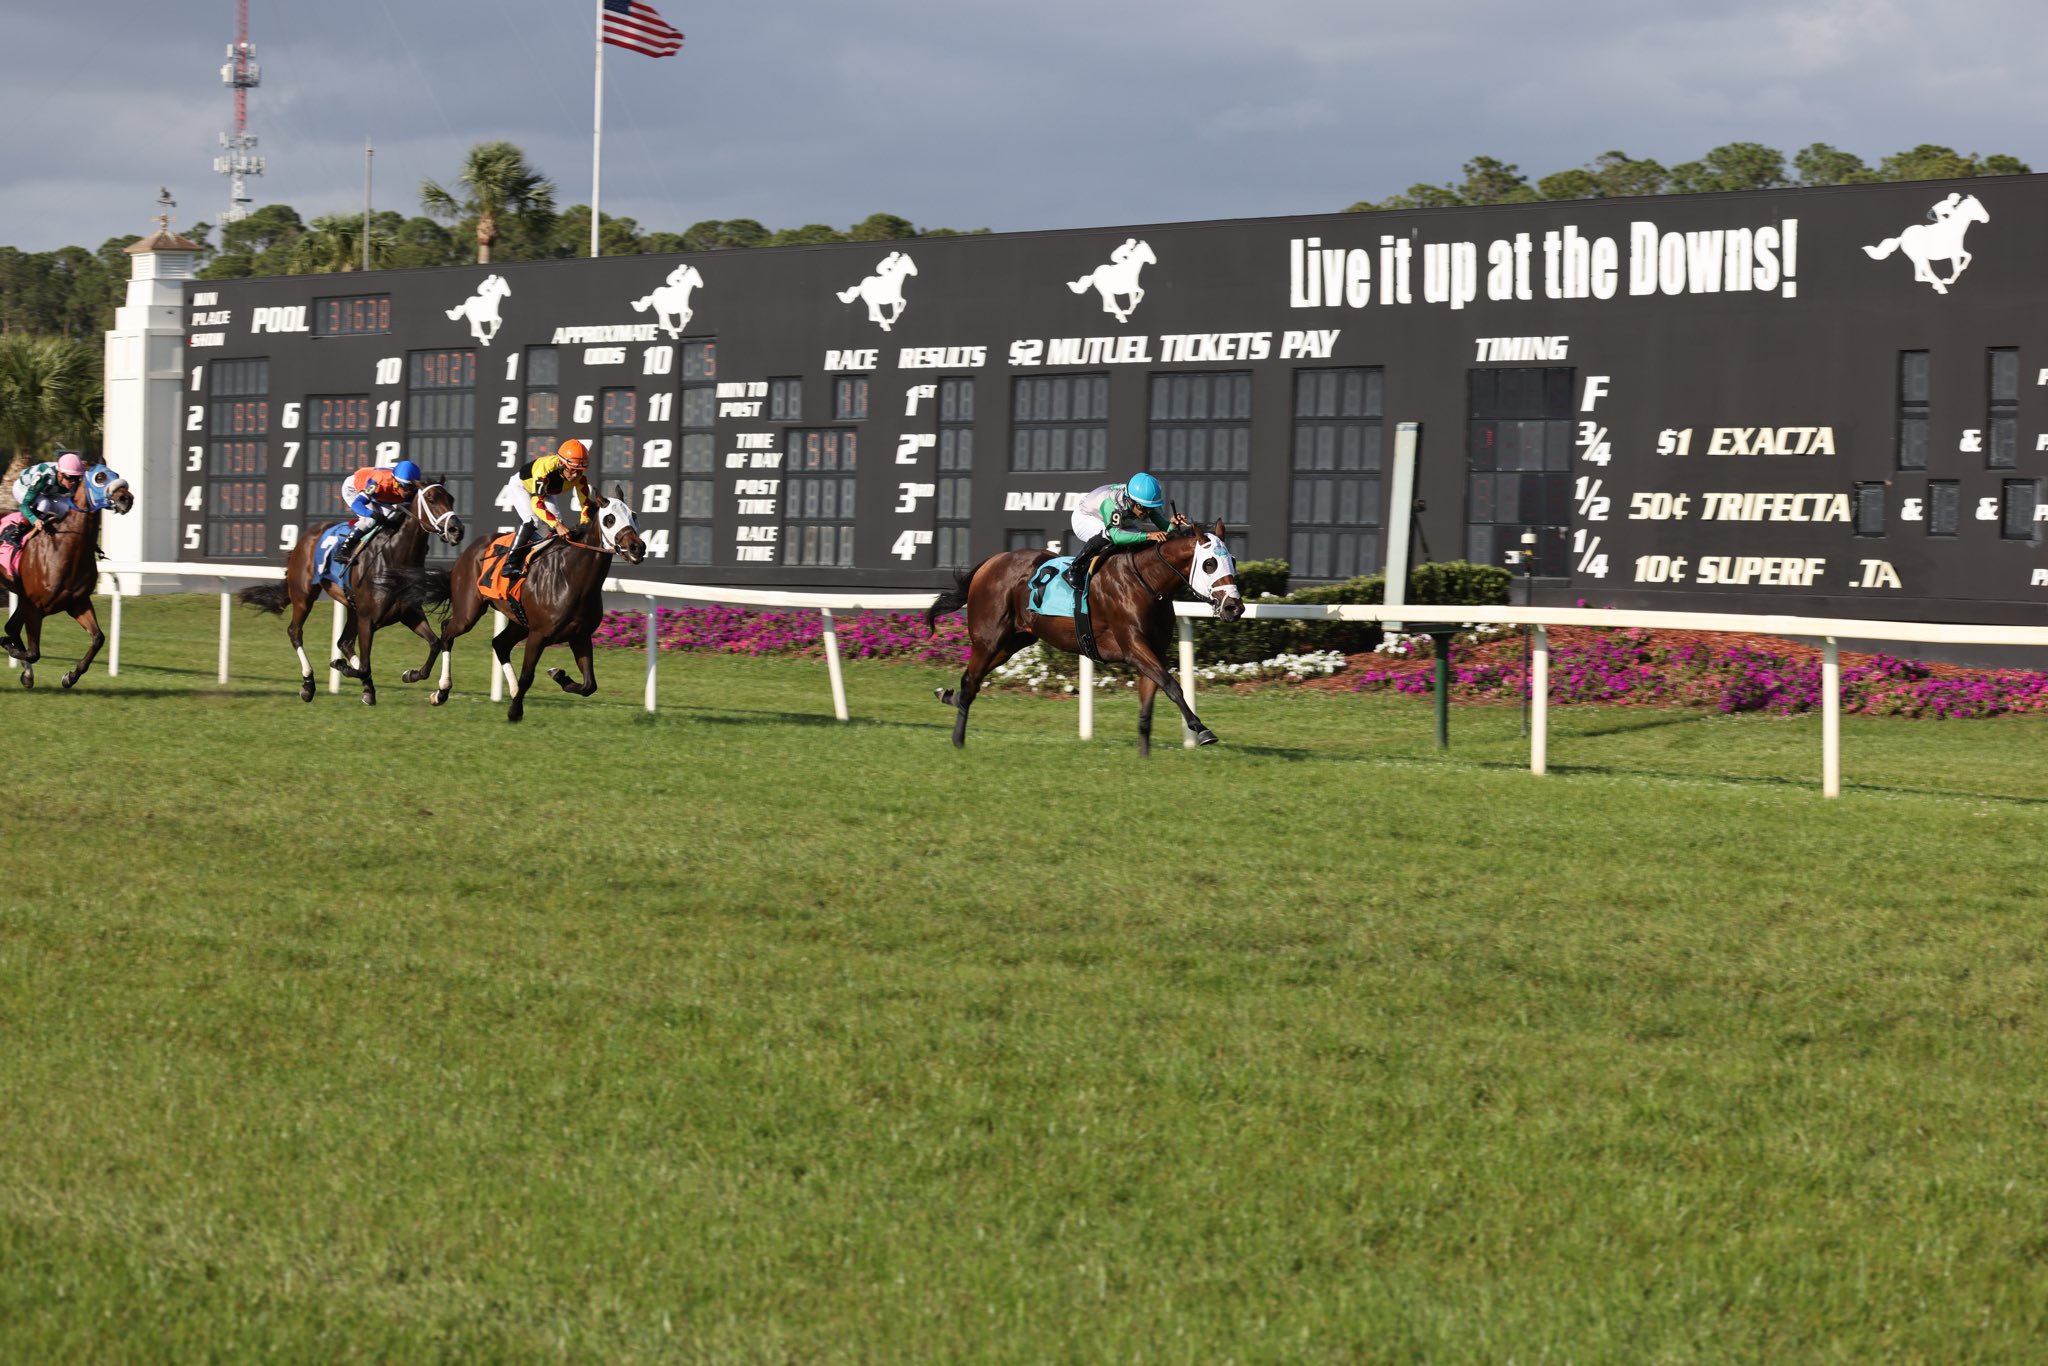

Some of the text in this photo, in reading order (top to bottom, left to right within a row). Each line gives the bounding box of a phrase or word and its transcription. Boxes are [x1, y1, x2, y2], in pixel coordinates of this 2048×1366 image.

[1291, 218, 1799, 310] Live it up at the Downs!
[191, 310, 231, 326] PLACE
[250, 306, 310, 333] POOL
[551, 324, 659, 344] APPROXIMATE
[824, 346, 987, 371] RACE RESULTS
[1008, 329, 1341, 366] $2 MUTUEL TICKETS PAY
[1475, 336, 1570, 361] TIMING
[375, 357, 403, 385] 10
[506, 353, 520, 380] 1
[643, 346, 673, 375] 10
[191, 366, 203, 391] 1
[747, 382, 768, 397] TO
[1580, 376, 1611, 412] F
[187, 406, 204, 430] 2
[282, 403, 301, 428] 6
[321, 400, 370, 429] 2365
[376, 401, 401, 427] 11
[498, 397, 519, 424] 2
[573, 396, 595, 423] 6
[648, 393, 673, 421] 11
[719, 402, 763, 417] POST
[642, 439, 672, 468] 12
[736, 433, 774, 449] TIME
[1656, 428, 1693, 456] $1
[1707, 427, 1836, 455] EXACTA
[186, 446, 203, 471] 3
[282, 442, 300, 467] 7
[375, 442, 401, 468] 12
[497, 441, 518, 468] 3
[725, 453, 783, 468] OF DAY
[184, 486, 202, 511] 4
[280, 484, 299, 509] 8
[535, 481, 545, 495] 7
[642, 484, 671, 512] 13
[734, 480, 780, 494] POST
[1574, 476, 1611, 521] 1/2
[737, 499, 776, 514] TIME
[1004, 492, 1061, 511] DAILY
[1628, 493, 1691, 520] 50¢
[1701, 493, 1851, 521] TRIFECTA
[1111, 512, 1120, 527] 9
[184, 524, 202, 549] 5
[279, 525, 299, 550] 9
[736, 526, 779, 541] RACE
[736, 546, 775, 561] TIME
[1573, 528, 1609, 578] 1/4
[1634, 556, 1689, 583] 10¢
[1696, 556, 1826, 586] SUPERF
